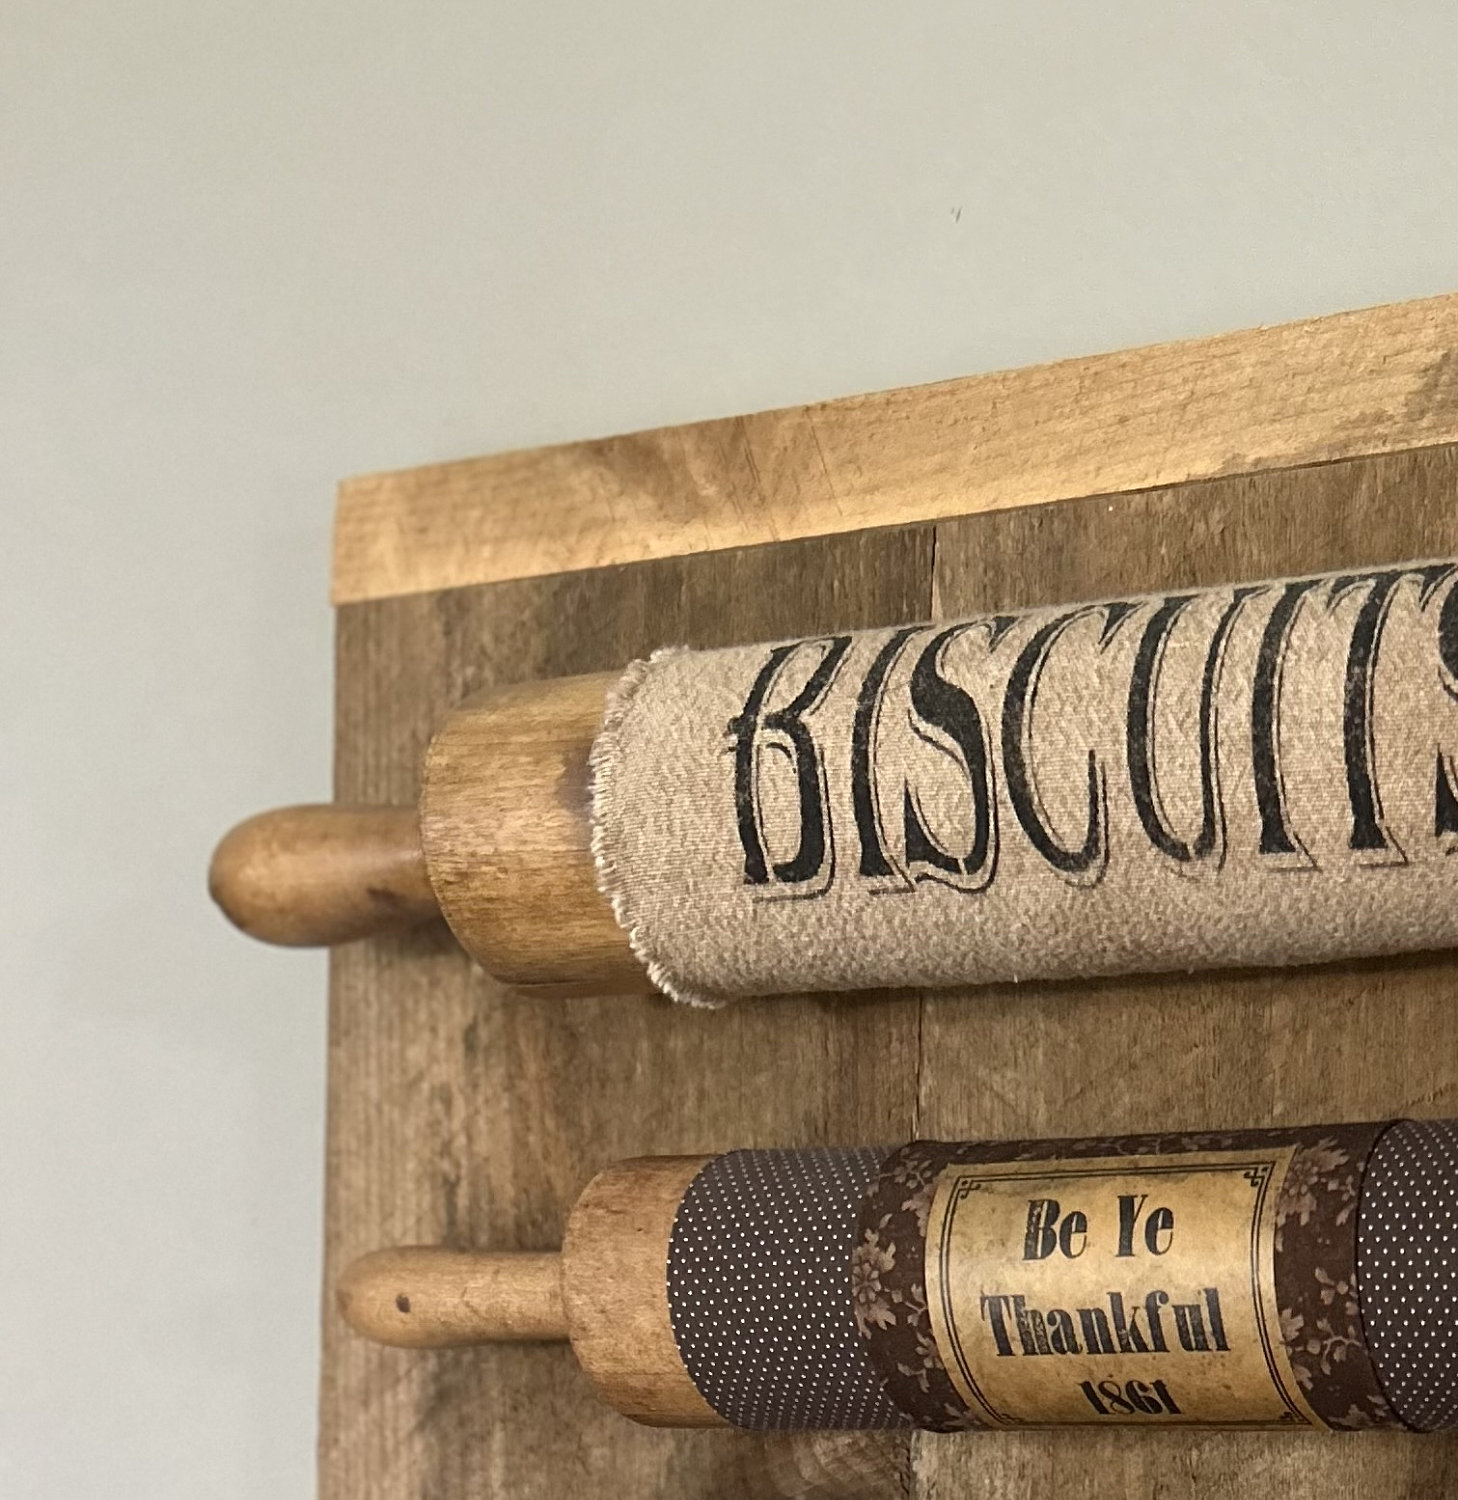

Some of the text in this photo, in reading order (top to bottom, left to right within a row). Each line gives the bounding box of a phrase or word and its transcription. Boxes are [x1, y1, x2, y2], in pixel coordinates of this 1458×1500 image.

[1021, 1194, 1175, 1261] Be Ye
[979, 1287, 1231, 1357] Thankful
[1077, 1378, 1183, 1416] 1861
